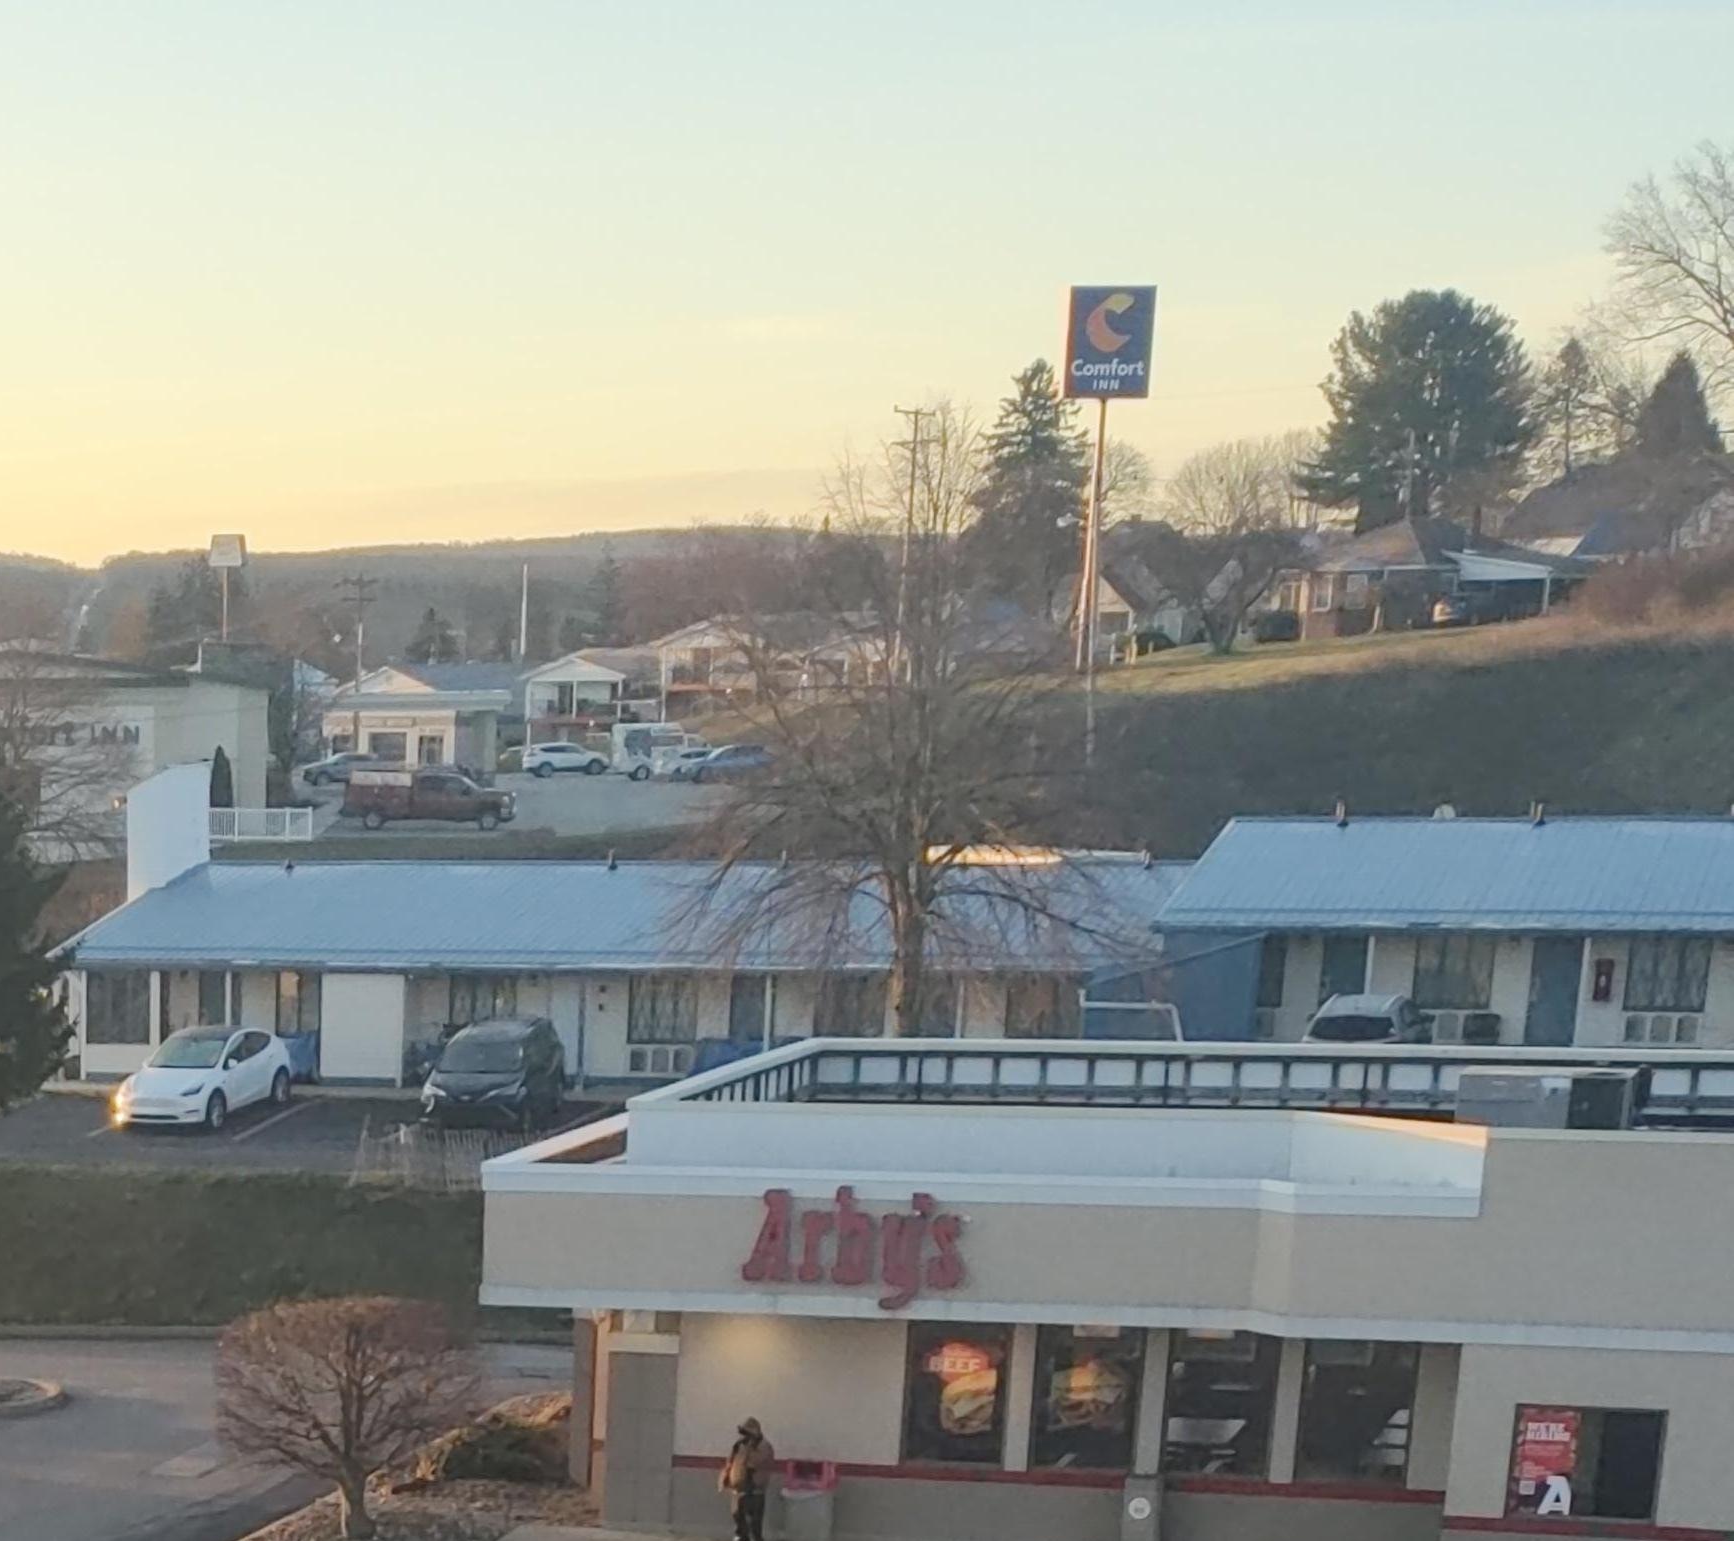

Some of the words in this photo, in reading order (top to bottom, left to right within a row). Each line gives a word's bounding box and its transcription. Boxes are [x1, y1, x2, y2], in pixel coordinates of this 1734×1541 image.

[1070, 357, 1145, 377] Comfort
[1092, 378, 1120, 391] INN
[741, 1184, 965, 1311] Arby's
[928, 1355, 982, 1374] BEEF
